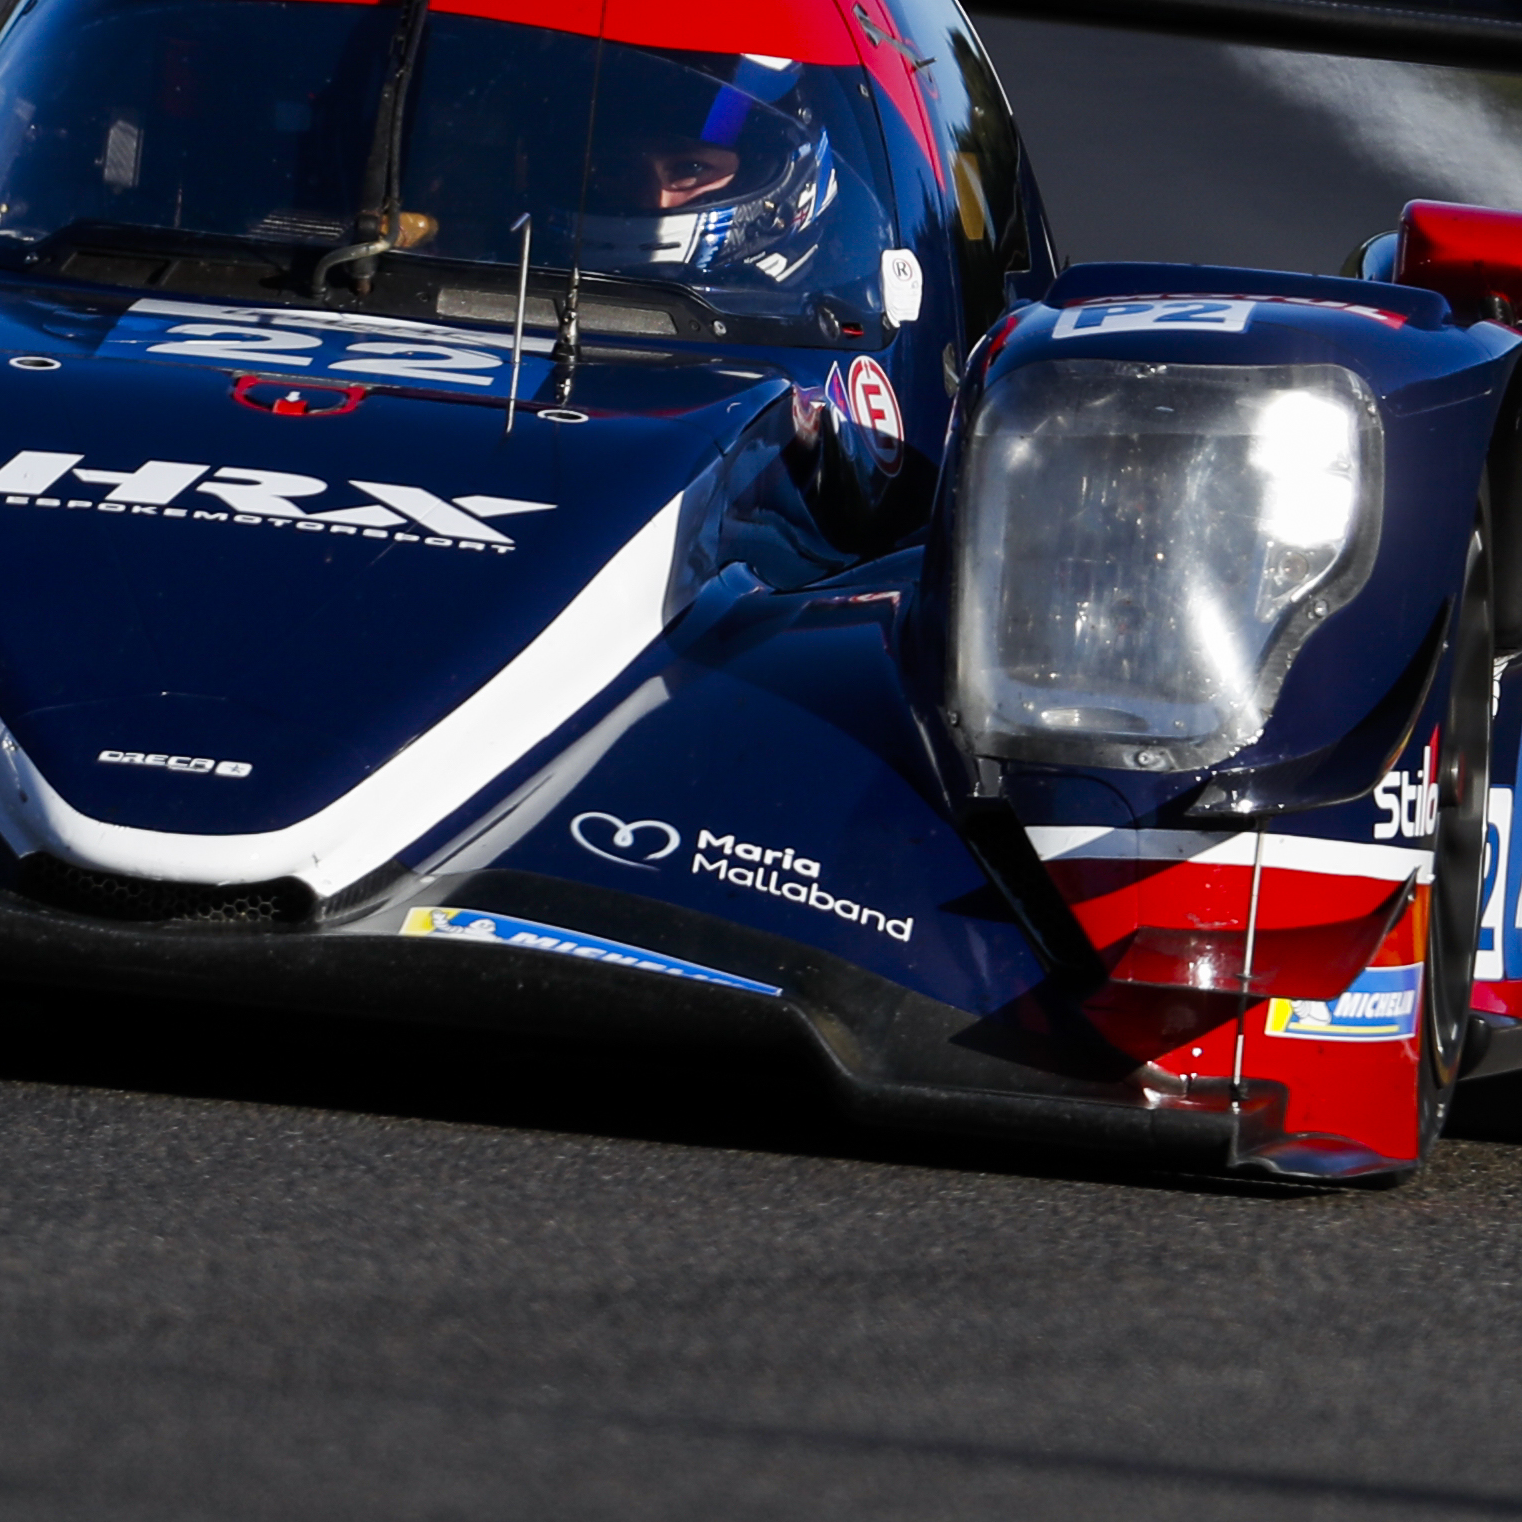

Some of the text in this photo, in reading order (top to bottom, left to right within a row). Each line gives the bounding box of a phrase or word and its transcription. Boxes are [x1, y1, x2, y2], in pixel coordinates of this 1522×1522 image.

[1074, 302, 1233, 330] P2
[146, 323, 503, 386] 22
[98, 750, 215, 772] ORECA
[1373, 745, 1438, 839] Stilo
[697, 829, 821, 878] Maria
[692, 853, 914, 943] Mallaband
